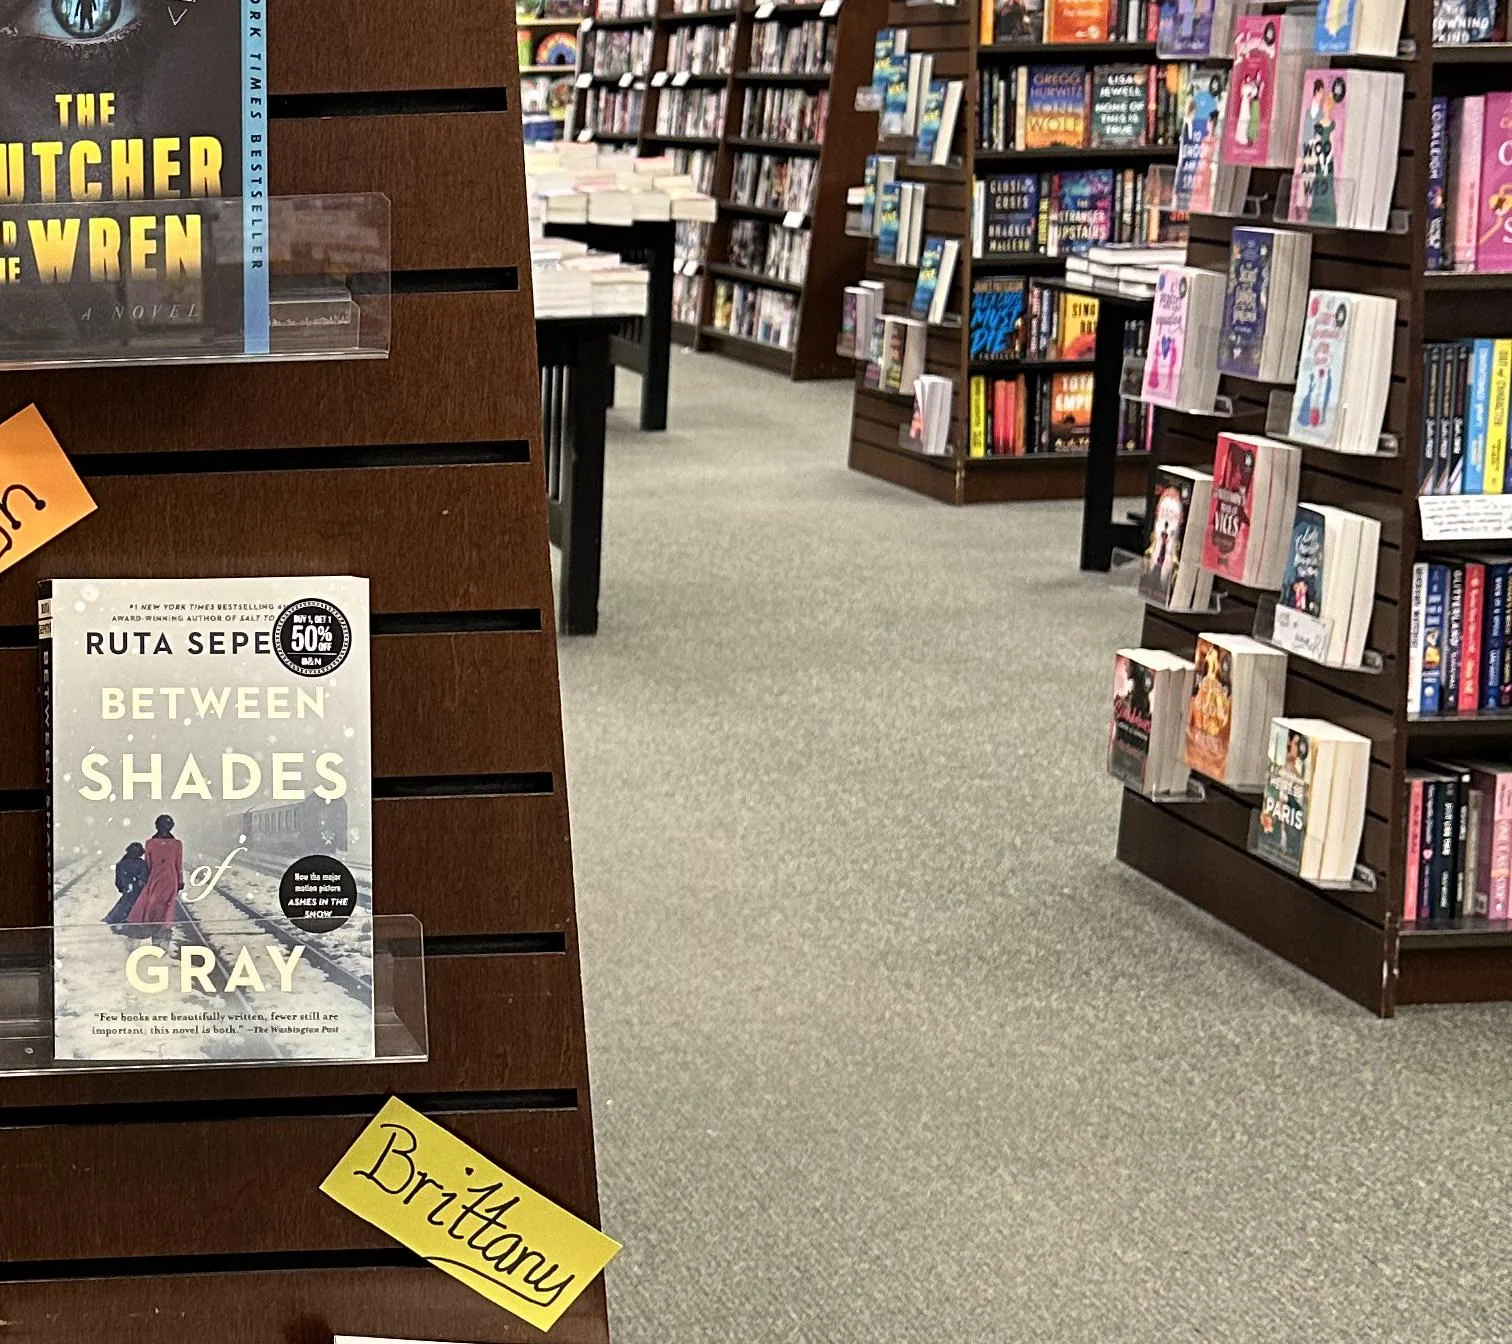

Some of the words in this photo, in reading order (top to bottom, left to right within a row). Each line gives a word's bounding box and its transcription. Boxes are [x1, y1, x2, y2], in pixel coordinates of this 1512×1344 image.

[54, 91, 116, 130] THE
[249, 50, 264, 121] TIMES
[249, 132, 265, 271] BESTSELLER
[27, 213, 204, 285] WREN
[85, 630, 174, 656] RUTA
[186, 630, 274, 655] SEPE
[100, 685, 326, 721] BETWEEN
[78, 750, 349, 802] SHADES
[180, 842, 248, 902] of
[124, 943, 307, 995] GRAY
[352, 1122, 576, 1308] Brittany
